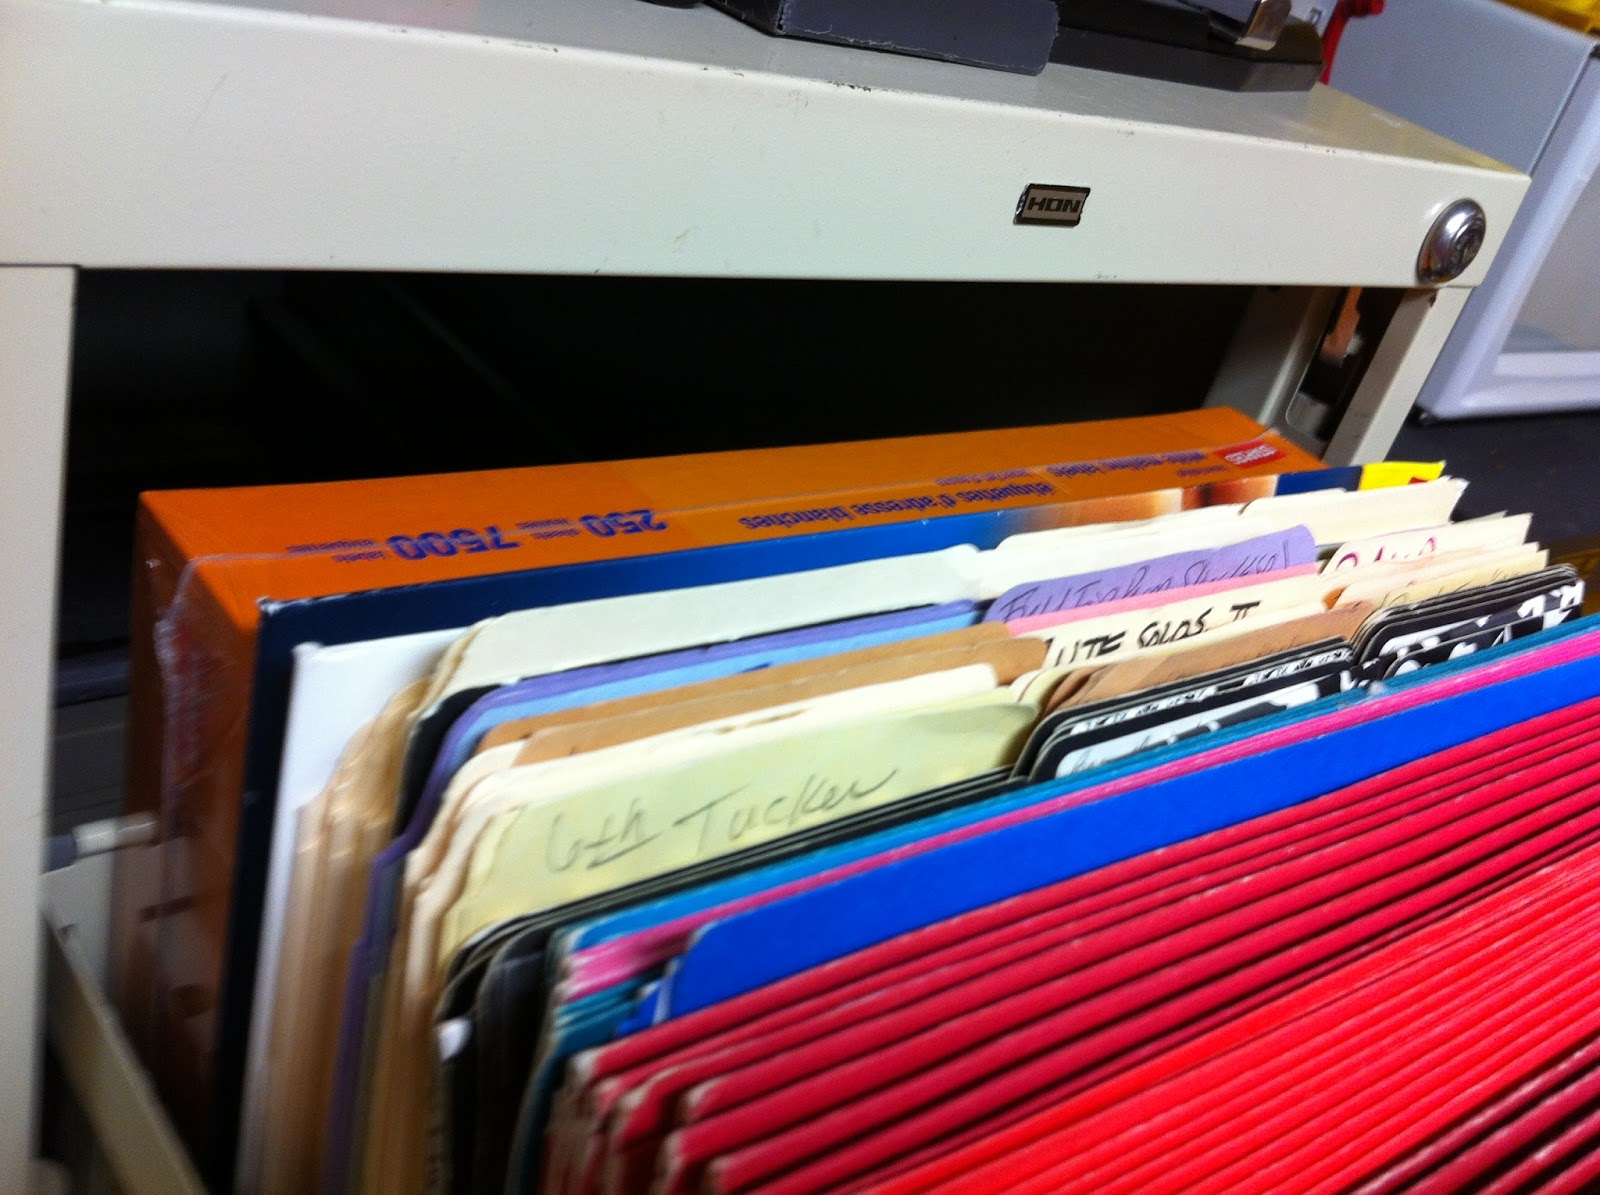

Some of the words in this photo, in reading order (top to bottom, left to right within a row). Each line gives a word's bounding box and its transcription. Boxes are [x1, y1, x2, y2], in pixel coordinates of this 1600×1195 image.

[1027, 197, 1081, 214] HON
[578, 508, 669, 538] 250
[738, 504, 855, 529] blanches
[386, 524, 521, 562] 7500
[672, 769, 899, 857] Tucker
